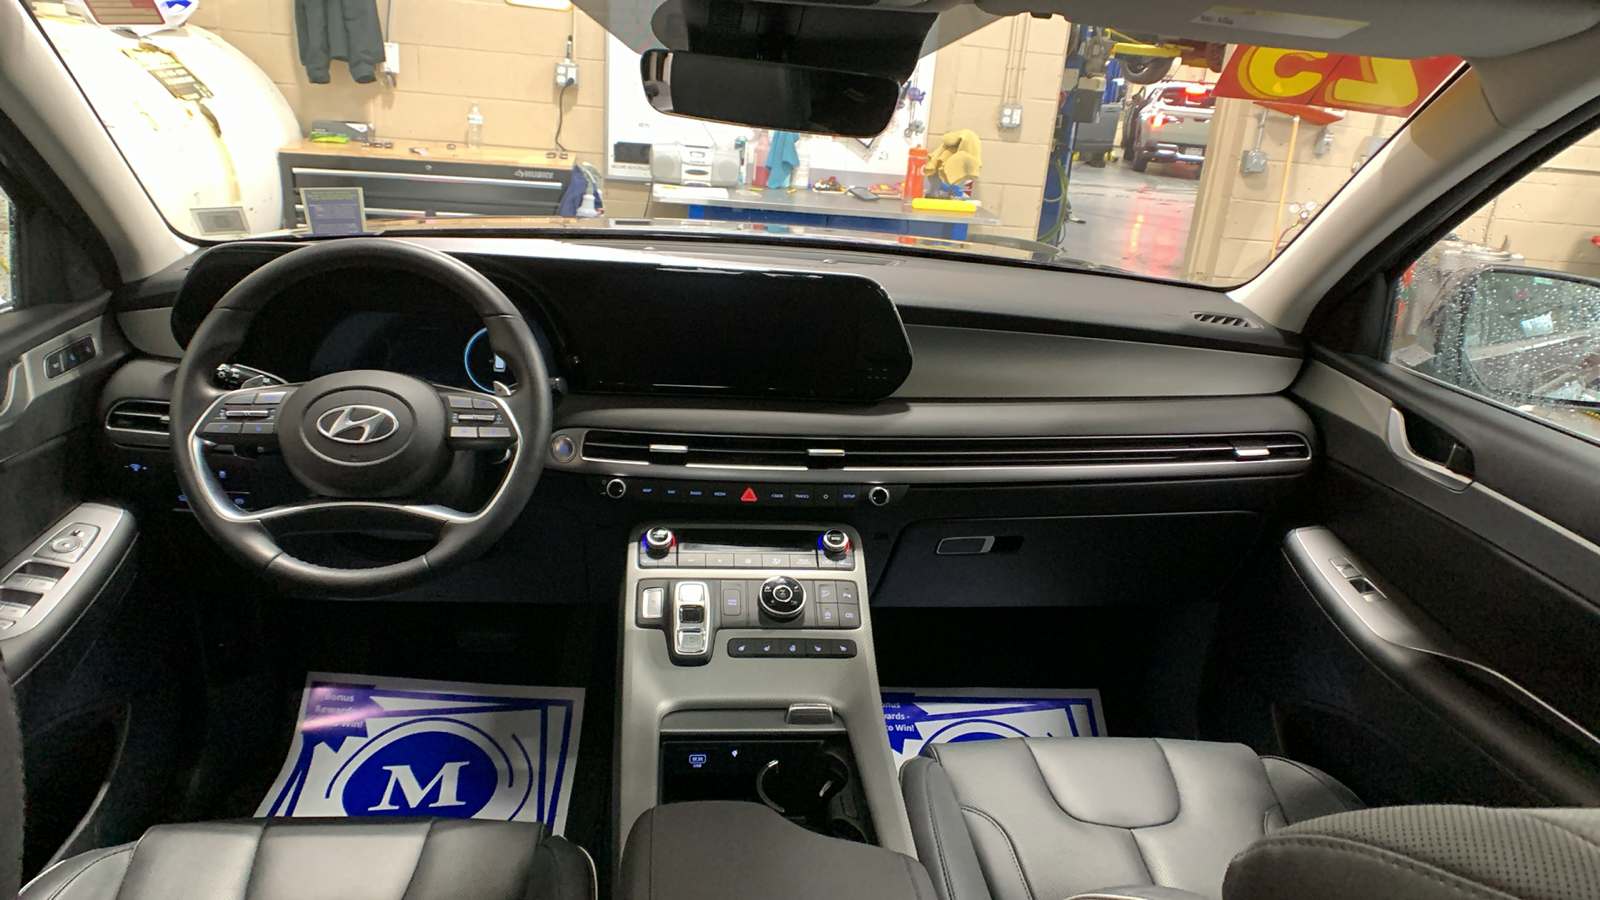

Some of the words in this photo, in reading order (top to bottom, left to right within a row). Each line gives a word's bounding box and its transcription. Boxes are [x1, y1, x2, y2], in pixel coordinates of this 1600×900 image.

[524, 170, 554, 179] HUSKY
[884, 712, 905, 720] ards
[895, 724, 915, 732] Win!
[367, 760, 471, 812] M
